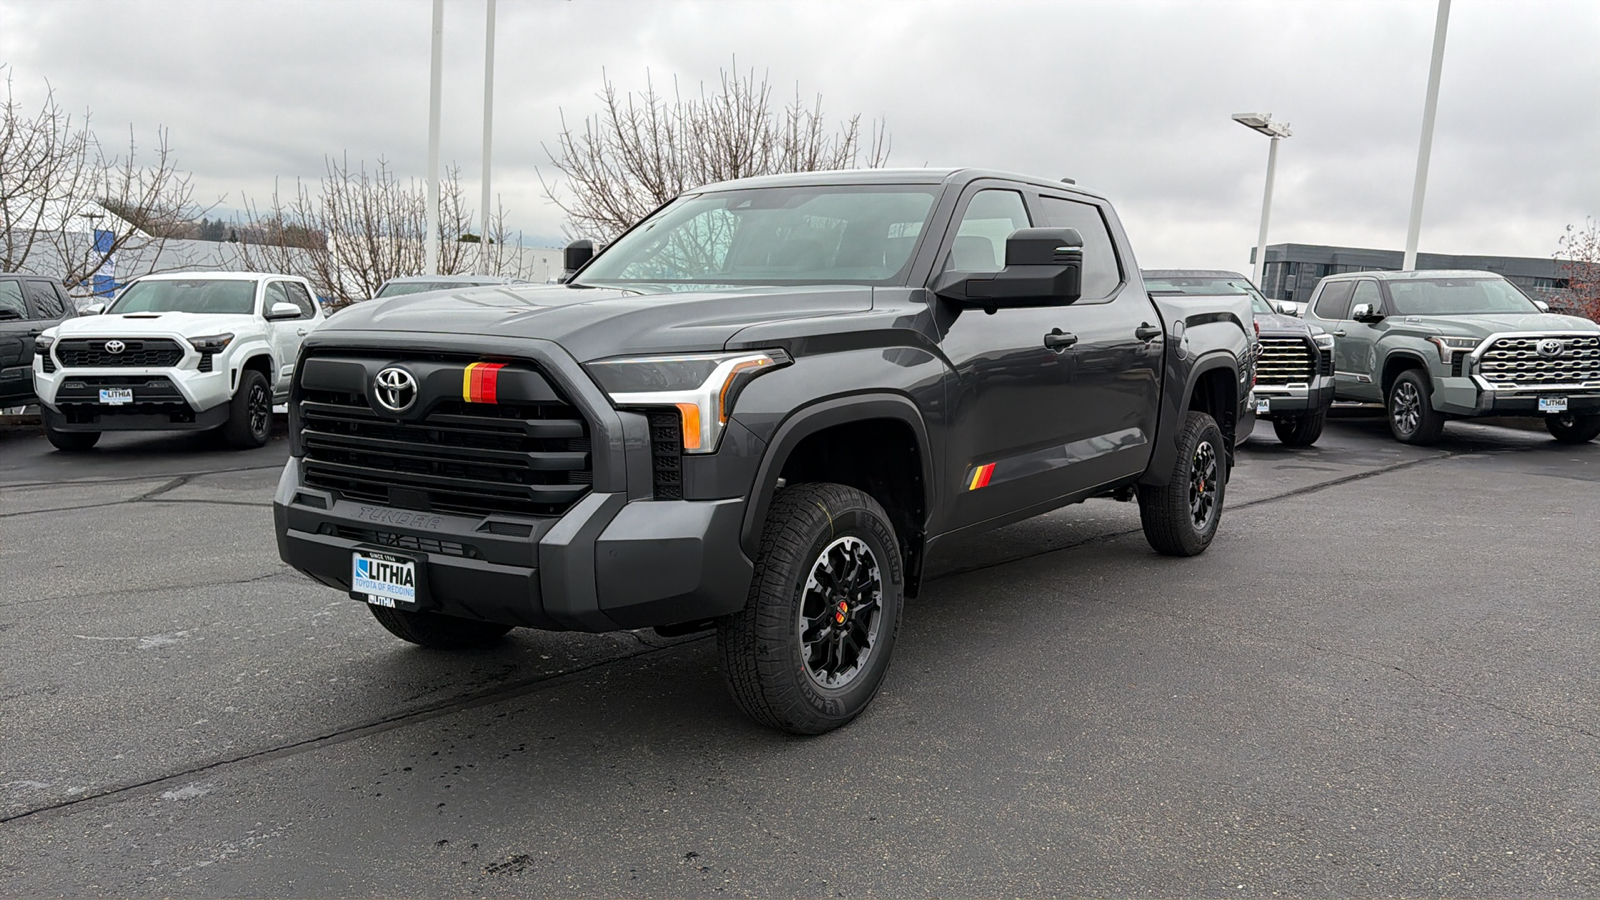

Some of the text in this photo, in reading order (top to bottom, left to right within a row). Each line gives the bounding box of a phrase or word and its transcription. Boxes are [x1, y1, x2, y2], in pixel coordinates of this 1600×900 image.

[873, 522, 901, 582] MICHELIN
[368, 560, 414, 588] LITHIA
[355, 578, 414, 598] TOYOTA OF REDDING
[374, 595, 396, 609] LITHIA
